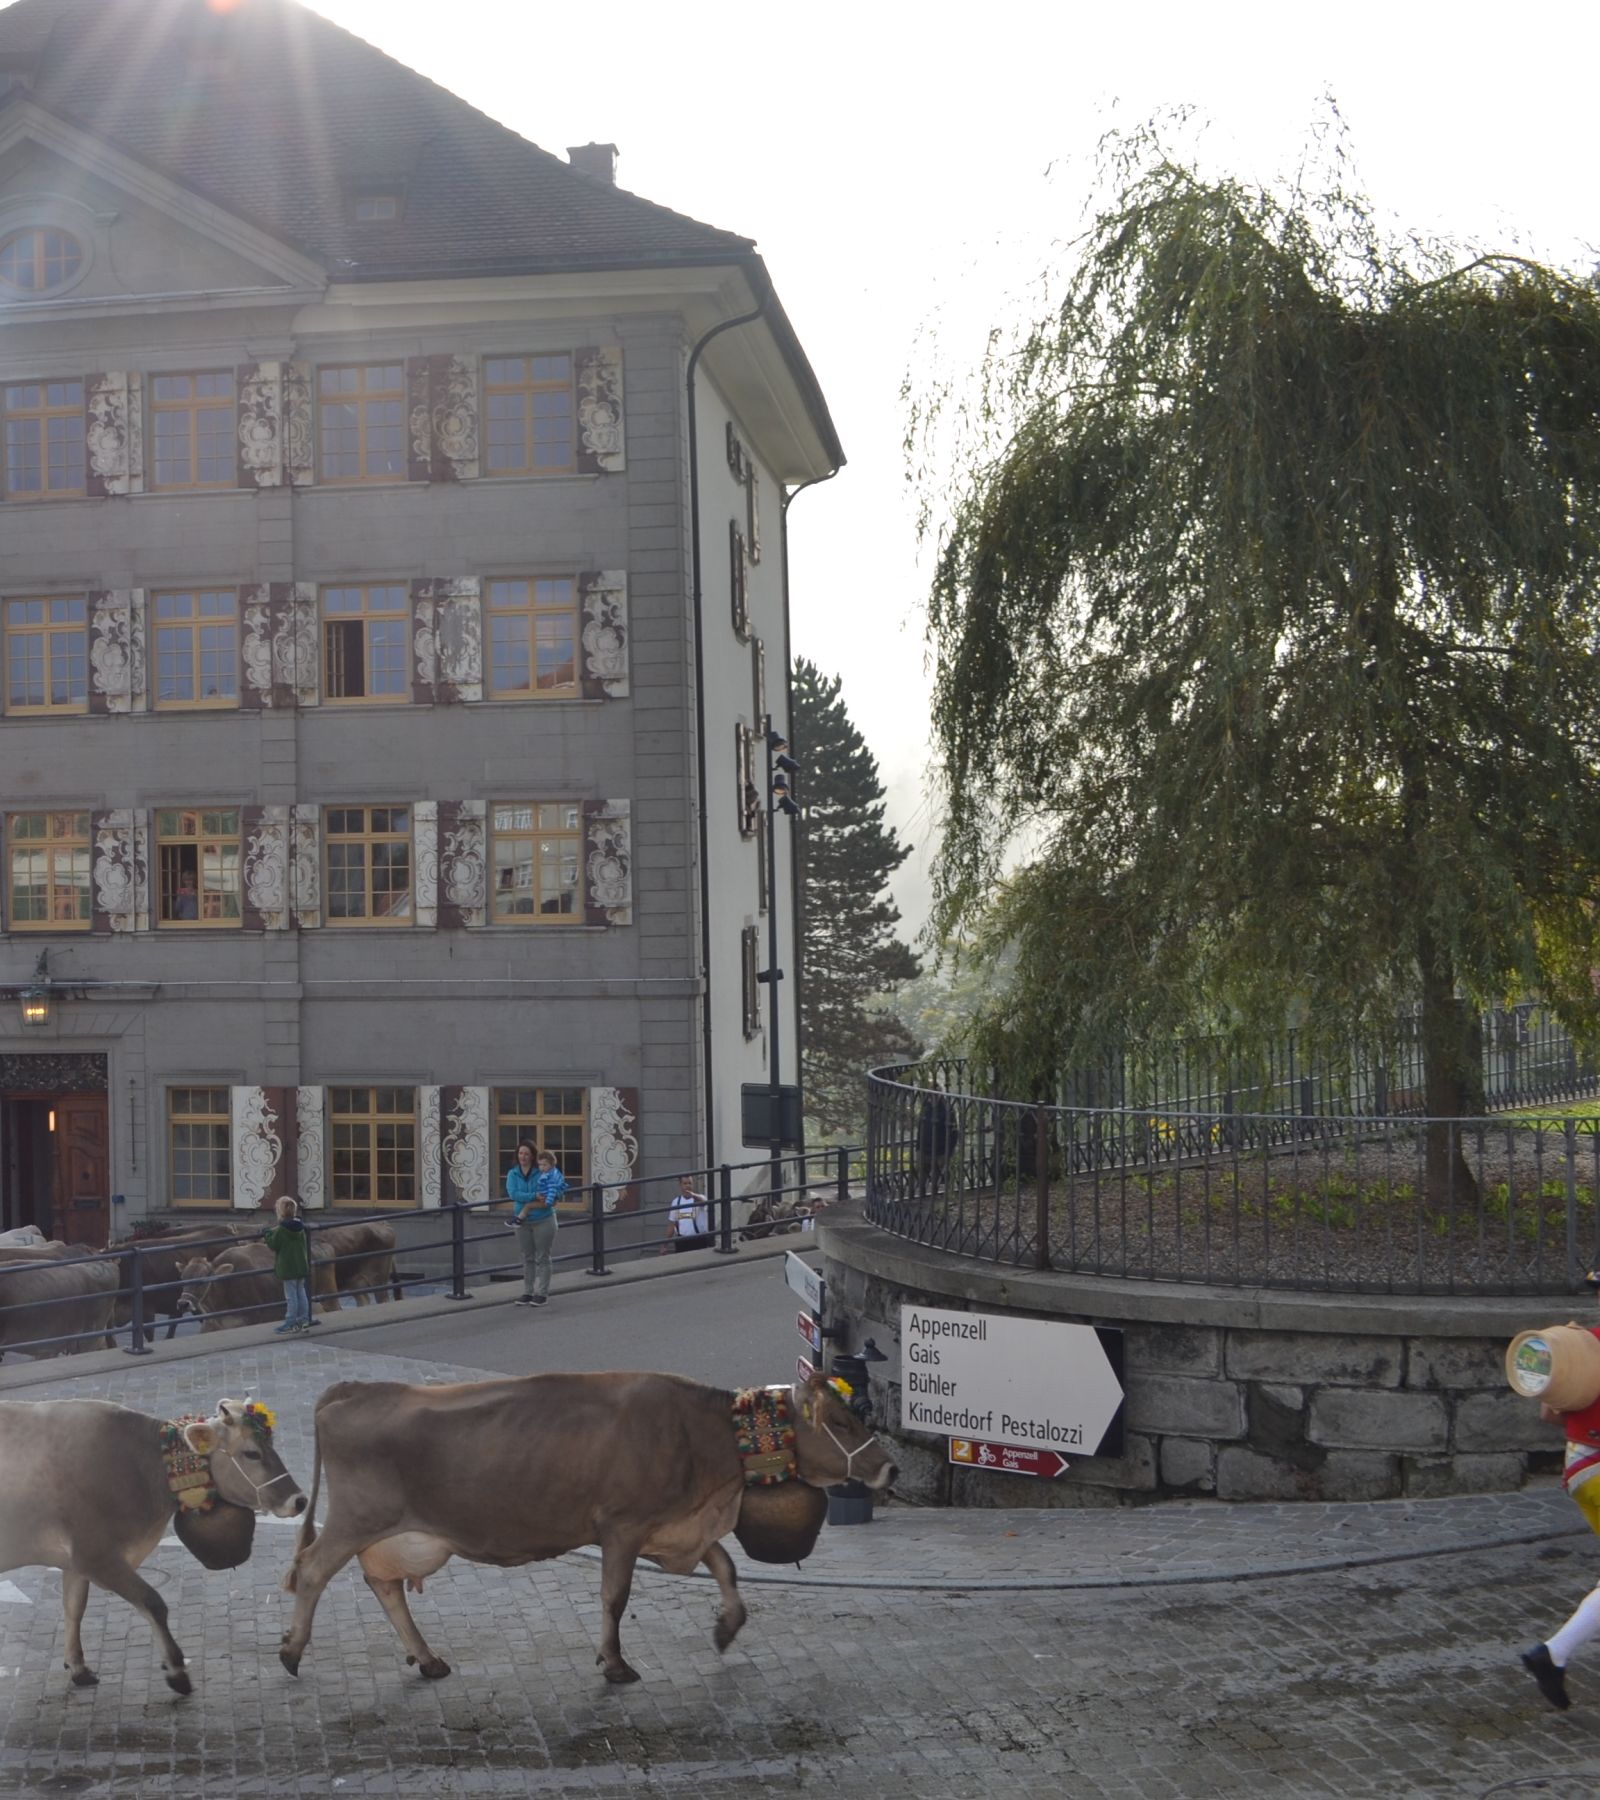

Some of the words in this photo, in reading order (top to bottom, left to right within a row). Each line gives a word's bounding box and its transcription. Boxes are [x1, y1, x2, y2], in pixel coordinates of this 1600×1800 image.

[909, 1313, 987, 1341] Appenzell
[909, 1342, 941, 1365] Gais
[908, 1371, 957, 1397] Bühler
[908, 1401, 993, 1433] Kinderdorf
[1001, 1414, 1083, 1445] Pestalozzi
[956, 1440, 969, 1457] 2
[1002, 1447, 1038, 1460] Appenzell
[1002, 1458, 1020, 1469] Gais
